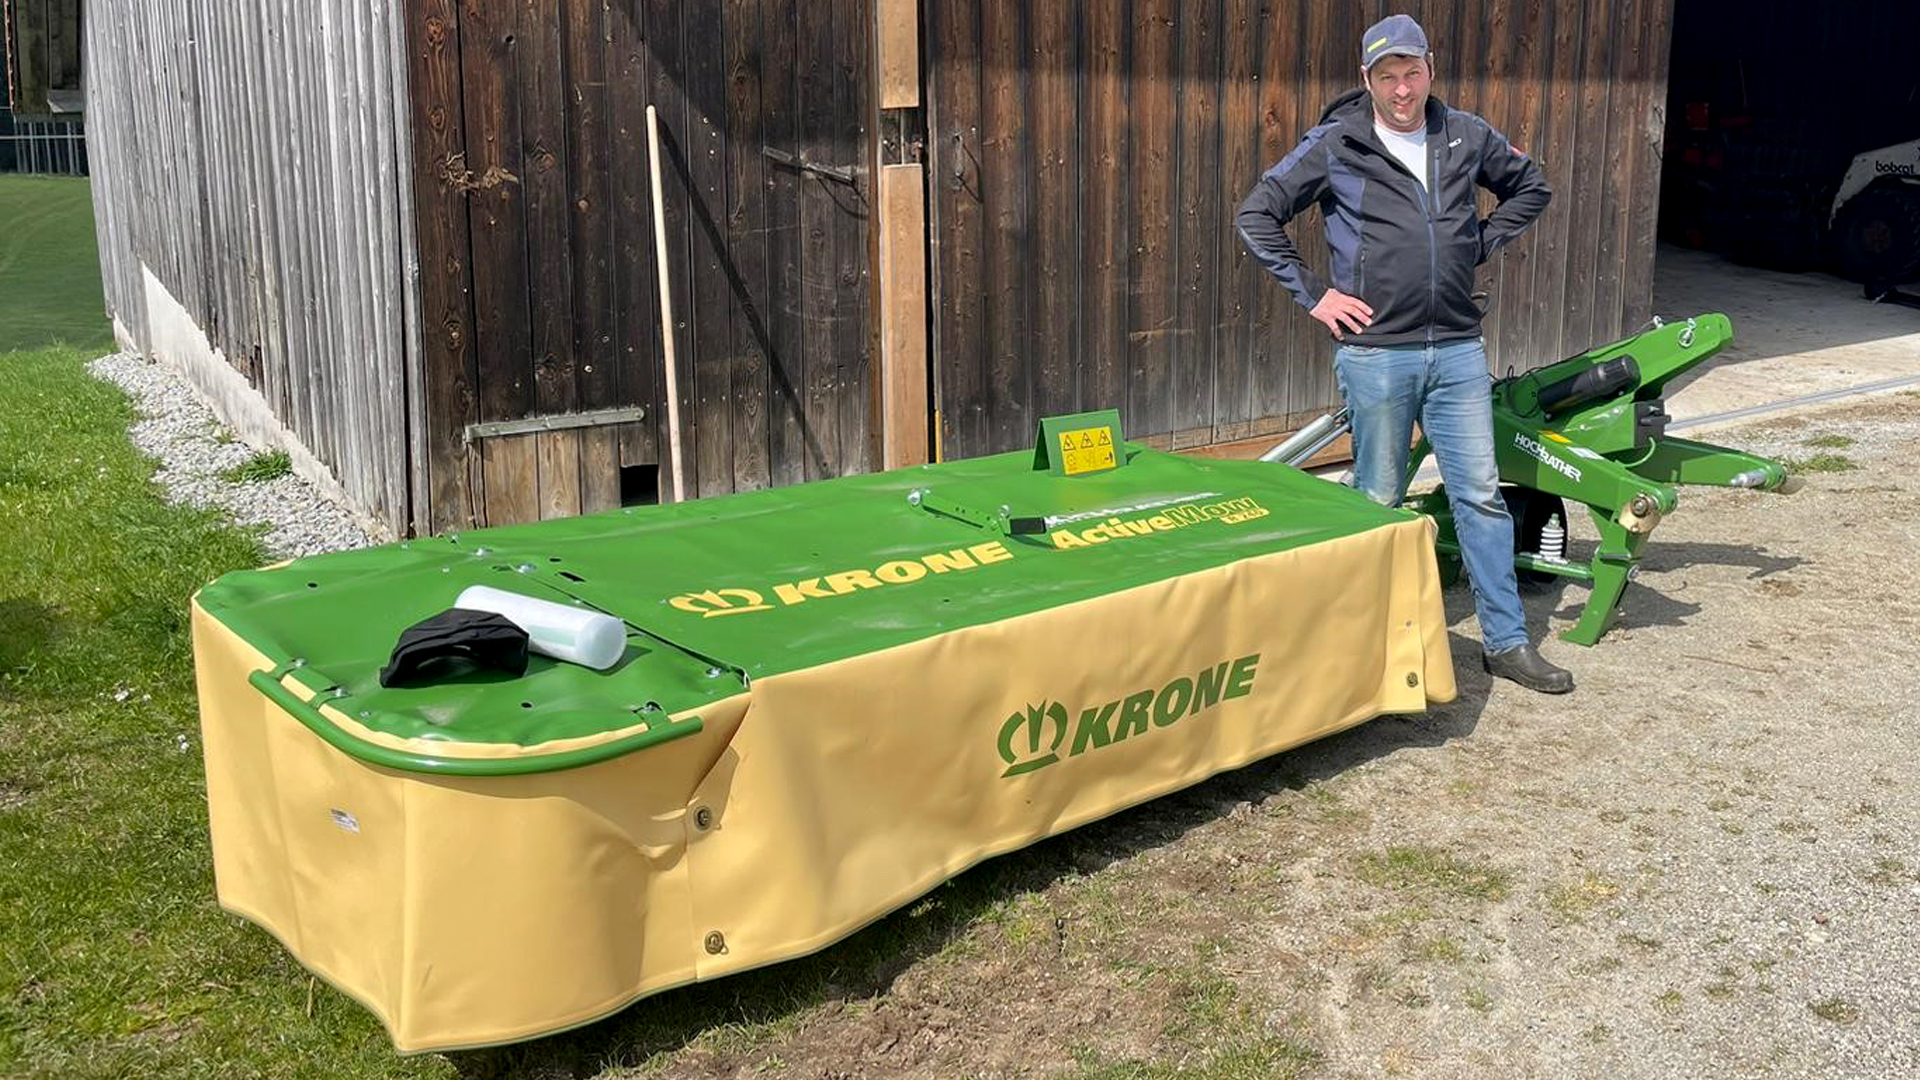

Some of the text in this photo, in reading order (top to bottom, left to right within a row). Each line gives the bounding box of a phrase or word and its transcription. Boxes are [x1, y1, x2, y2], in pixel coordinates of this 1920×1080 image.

[1875, 160, 1914, 175] bobcat
[1514, 432, 1582, 483] HOCHRATHER
[1051, 497, 1260, 549] ActiveMow
[773, 541, 1014, 605] KRONE
[1069, 653, 1261, 757] KRONE
